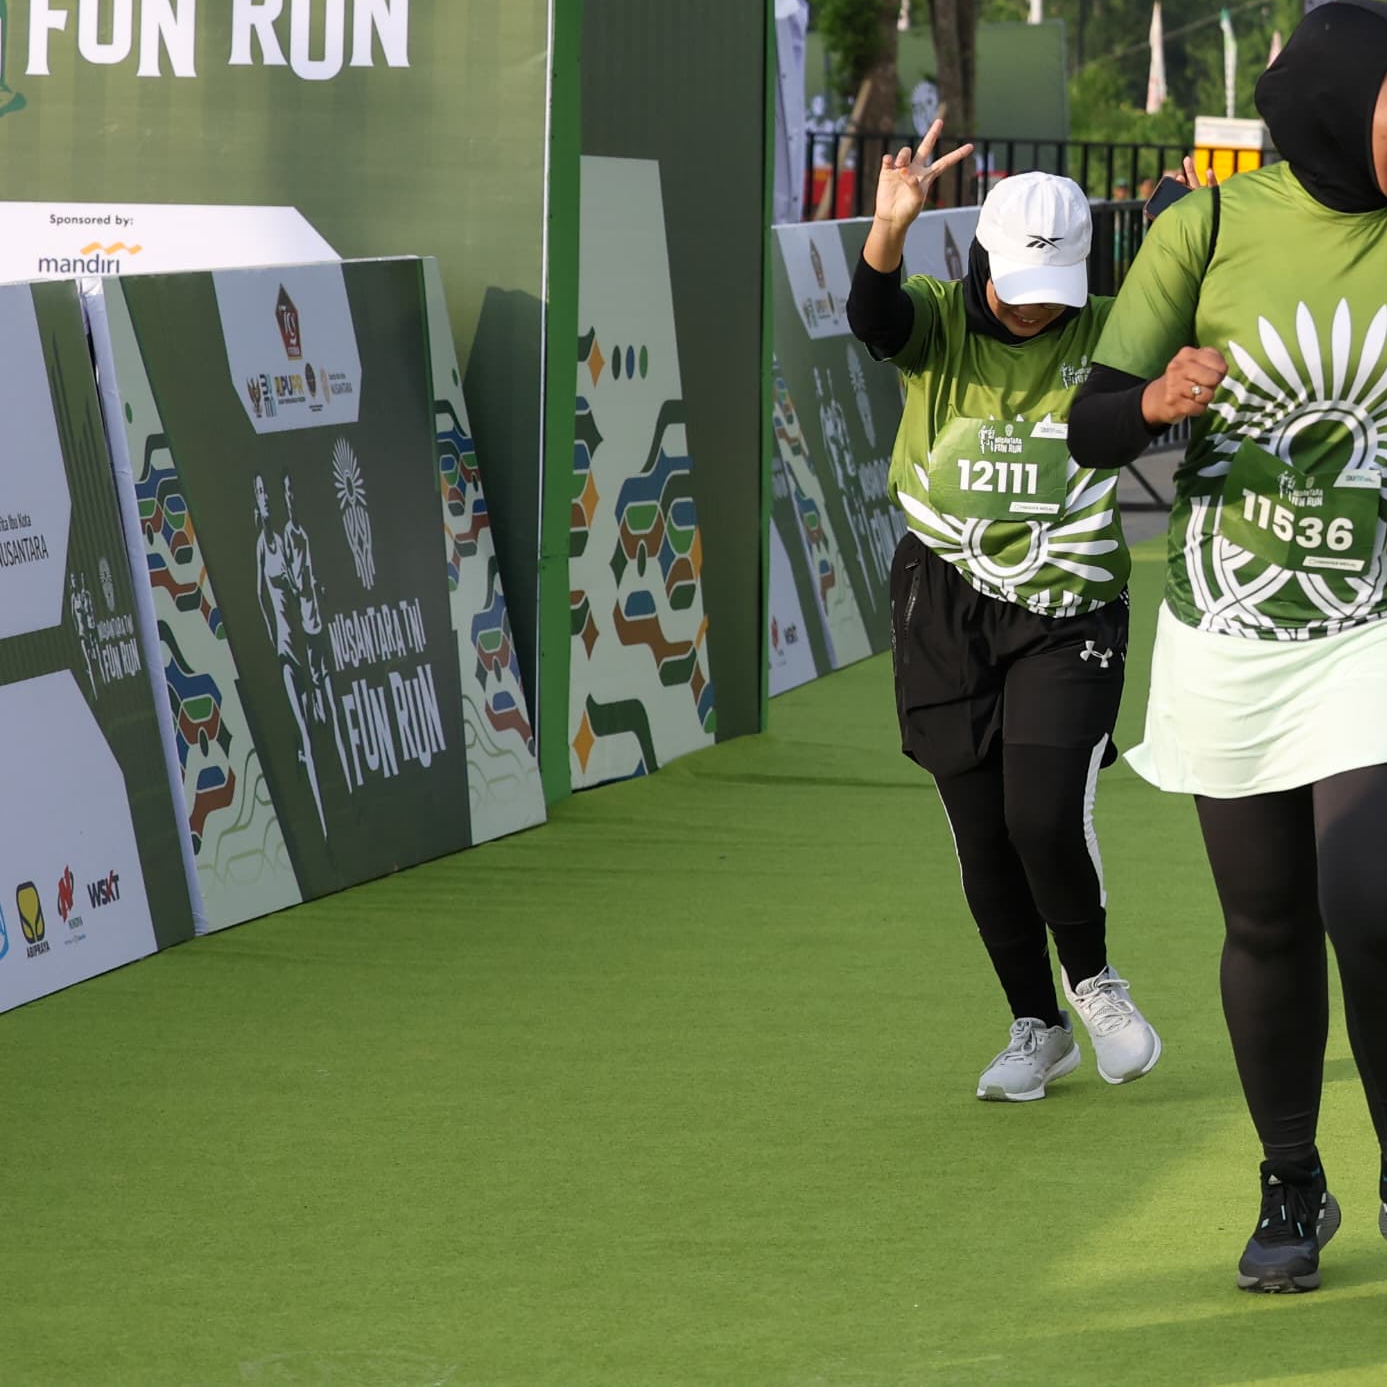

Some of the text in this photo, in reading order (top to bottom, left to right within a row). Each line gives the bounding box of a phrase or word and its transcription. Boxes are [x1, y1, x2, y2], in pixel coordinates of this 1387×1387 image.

[50, 214, 134, 227] Sponsored by:
[38, 254, 121, 274] mandiri
[957, 458, 1039, 495] 12111
[1242, 488, 1354, 552] 11536
[1306, 495, 1324, 507] RUN
[328, 598, 427, 672] NUSANTARA TNI
[103, 638, 142, 684] FUN RUN
[341, 663, 447, 786] FUN RUN
[87, 869, 120, 909] WSKT
